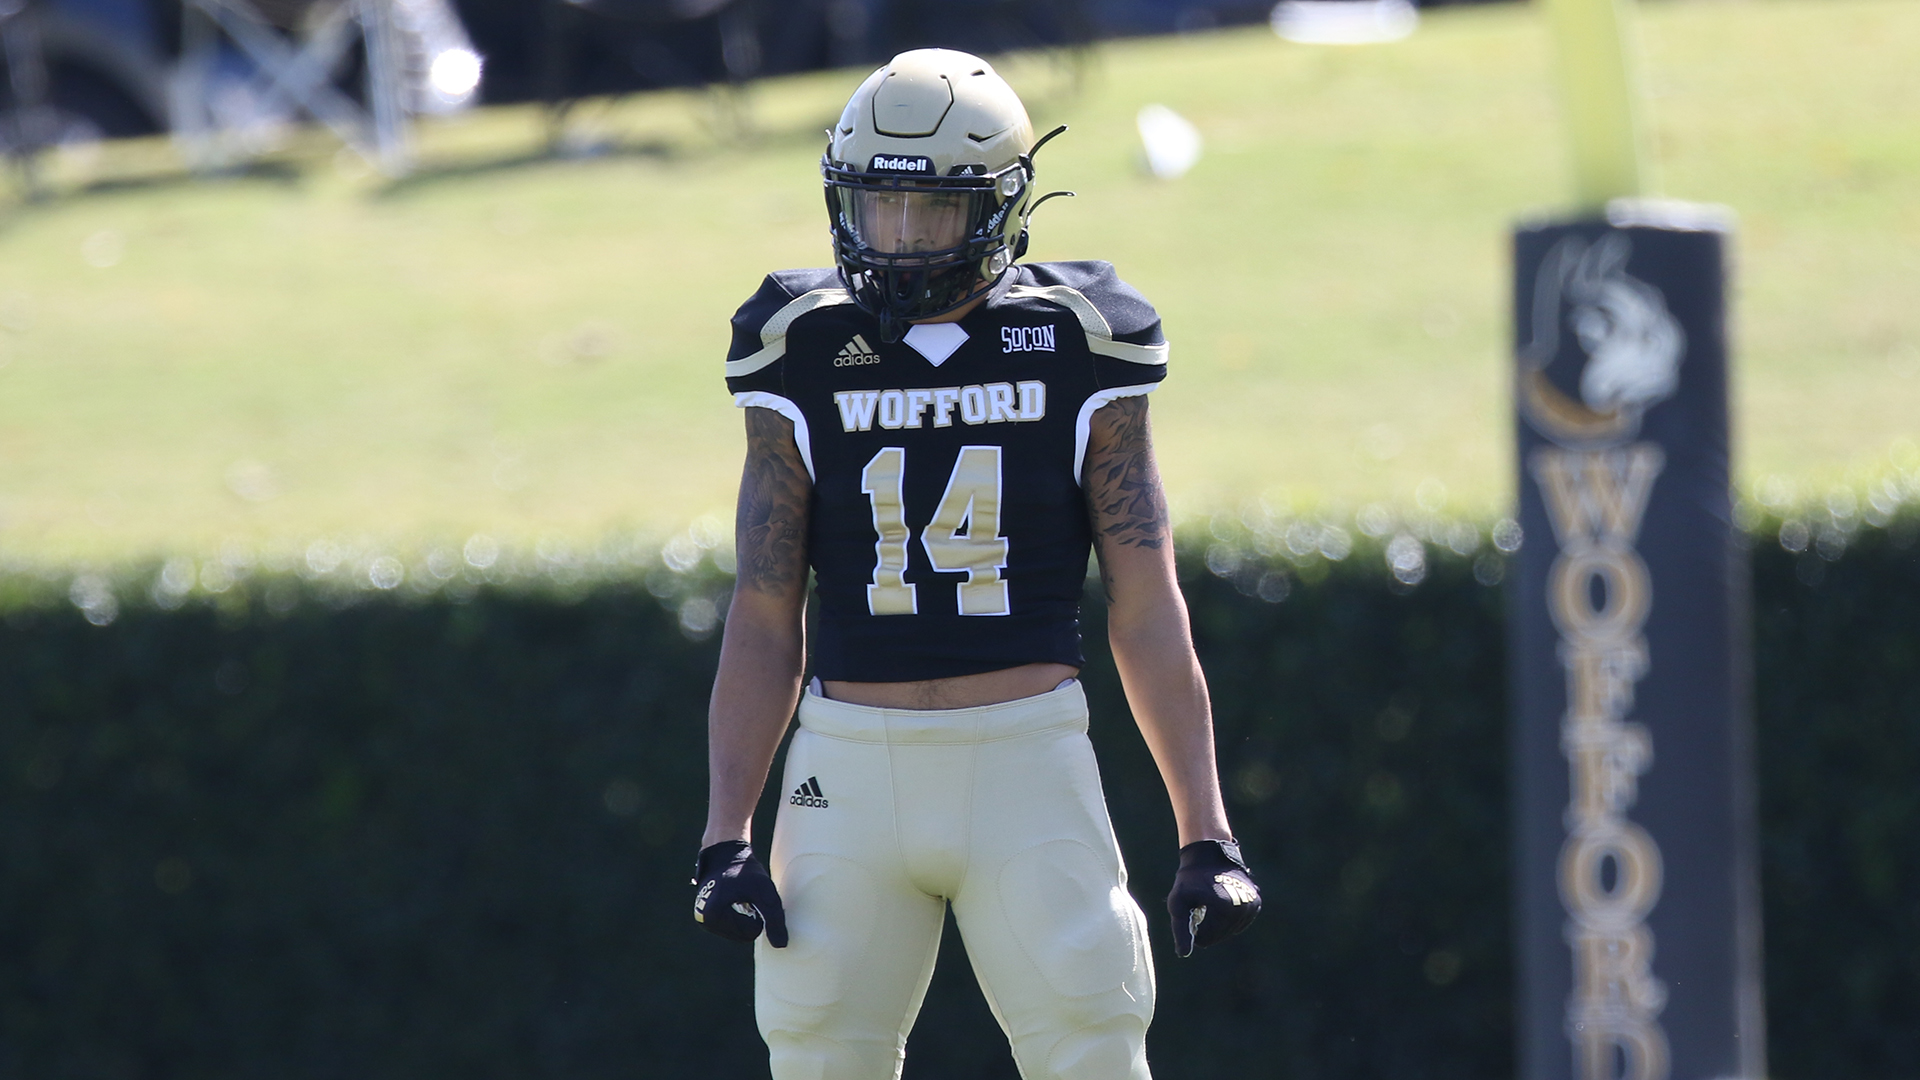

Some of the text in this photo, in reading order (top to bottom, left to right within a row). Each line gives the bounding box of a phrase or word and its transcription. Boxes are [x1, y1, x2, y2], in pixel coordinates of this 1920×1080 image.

[873, 156, 927, 172] Riddell
[1001, 324, 1056, 353] SOCON
[833, 351, 881, 367] adidas
[833, 379, 1046, 433] WOFFORD
[861, 445, 1011, 616] 14
[790, 795, 829, 809] adidas
